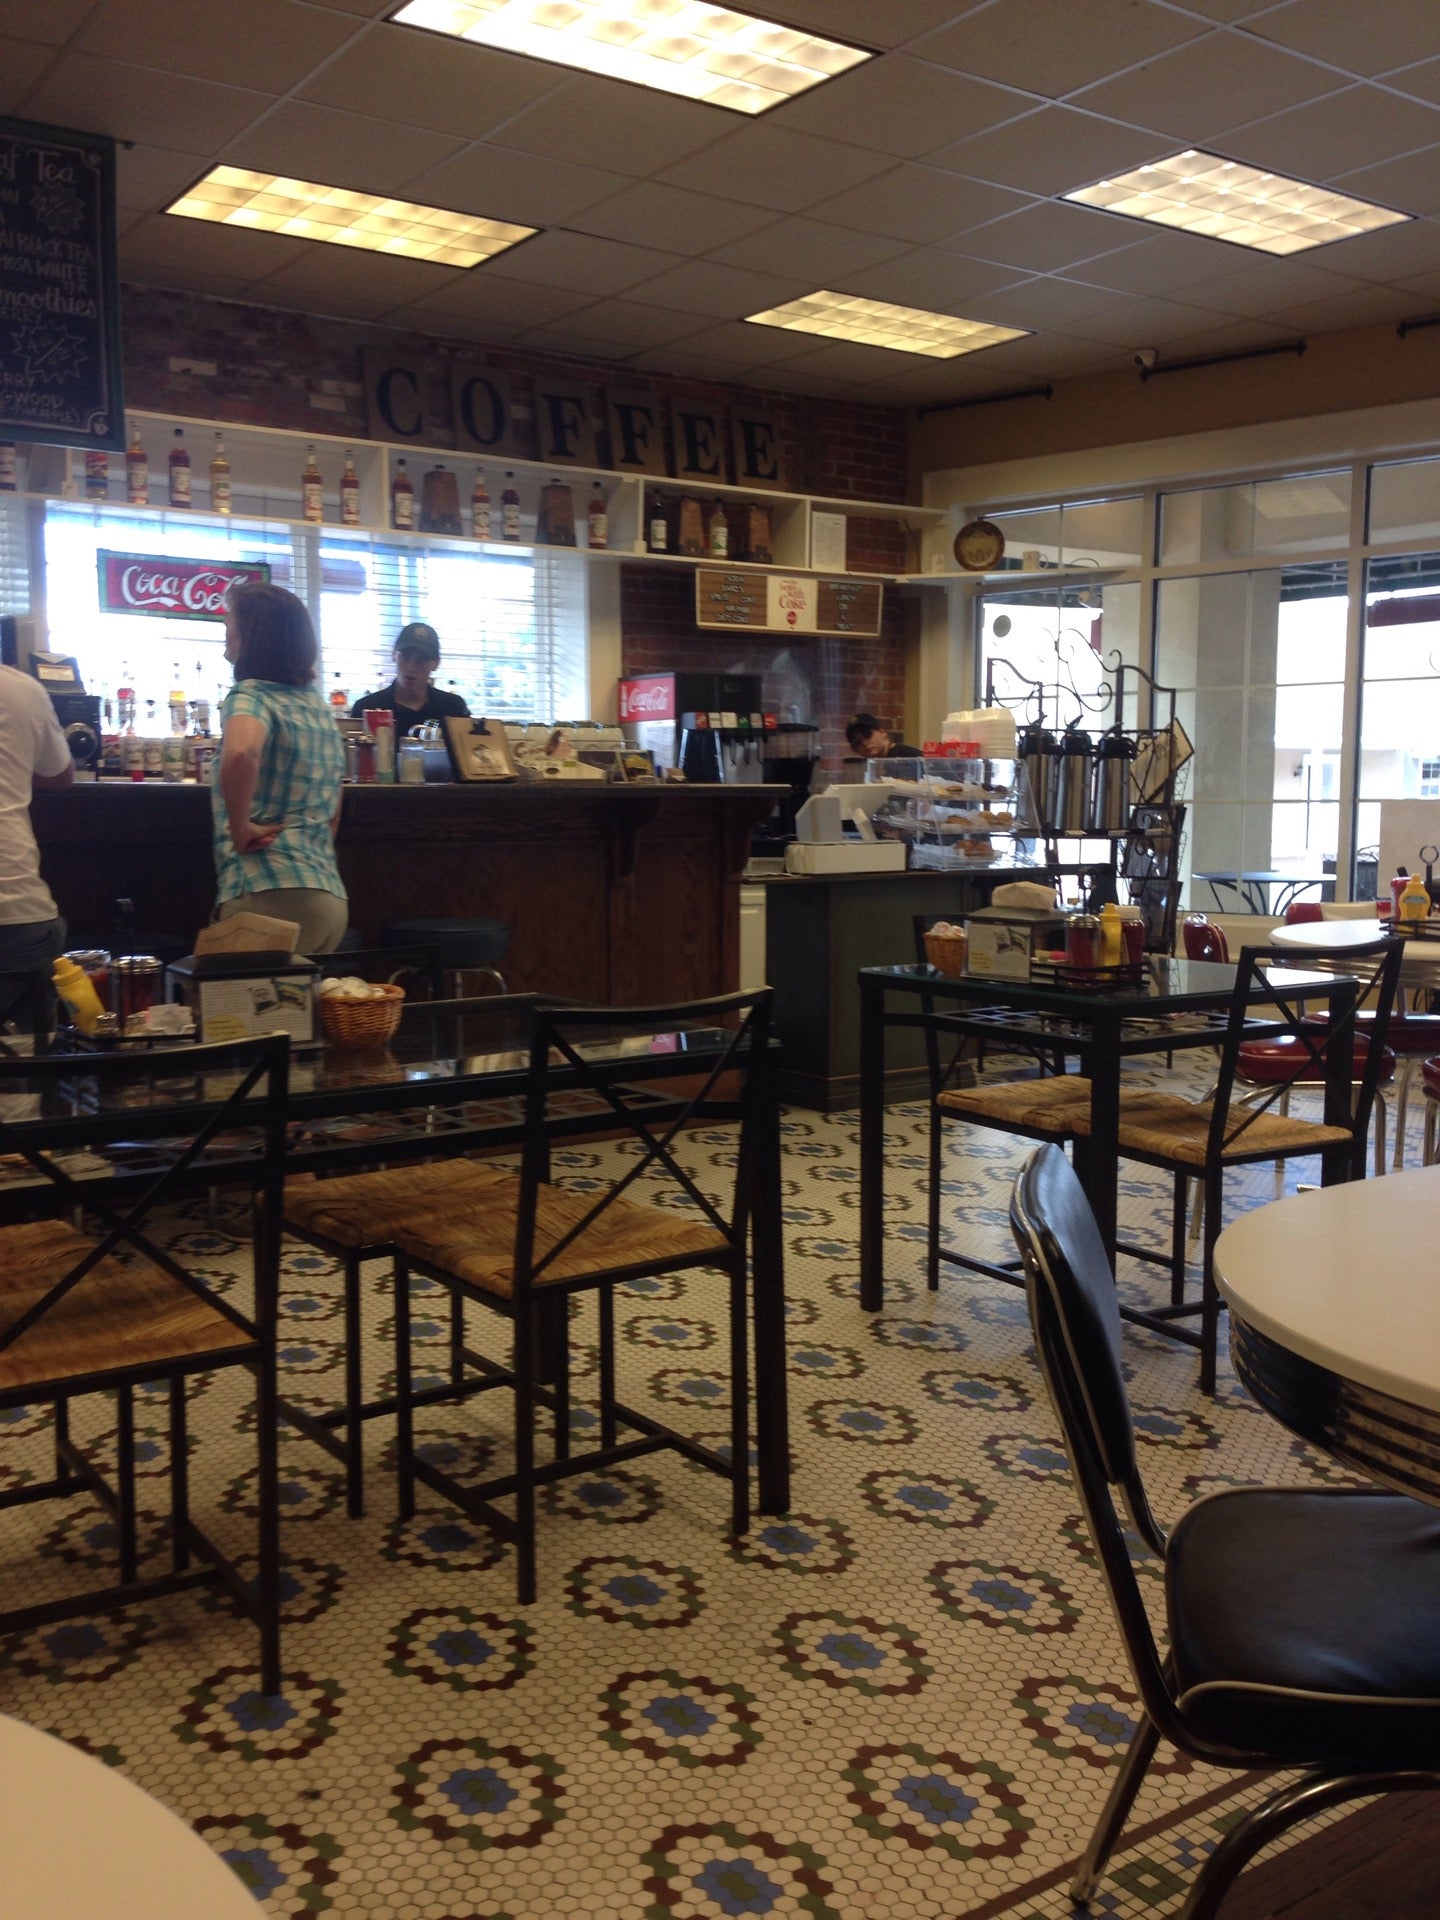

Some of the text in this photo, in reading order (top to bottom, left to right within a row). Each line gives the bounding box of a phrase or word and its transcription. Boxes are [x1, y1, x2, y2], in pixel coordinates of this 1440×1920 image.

[26, 148, 77, 183] Tea
[36, 260, 88, 283] WHITE
[374, 365, 780, 482] COFFEE
[120, 564, 249, 612] Coca-Col
